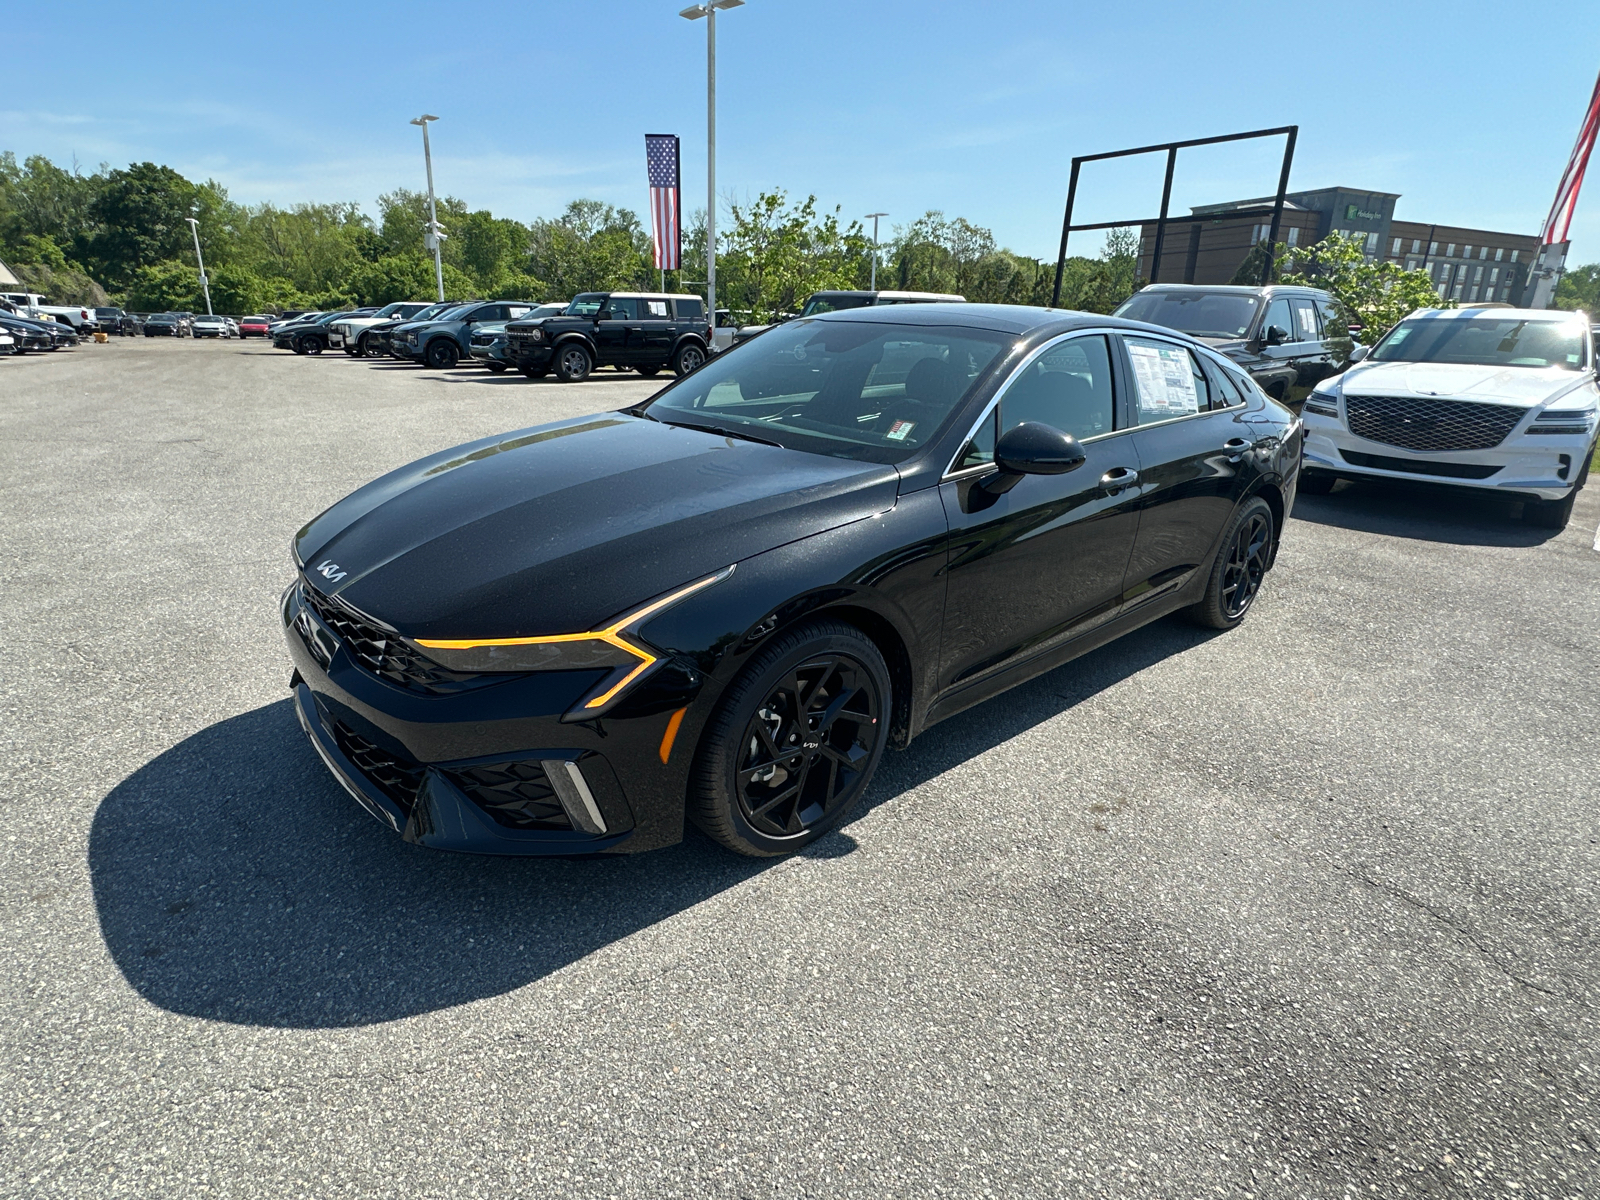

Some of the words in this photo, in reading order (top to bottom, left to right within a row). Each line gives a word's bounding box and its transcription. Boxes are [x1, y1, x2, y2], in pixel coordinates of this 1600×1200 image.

[1357, 209, 1374, 220] Holiday
[1374, 211, 1382, 219] Inn
[316, 559, 348, 583] KIA
